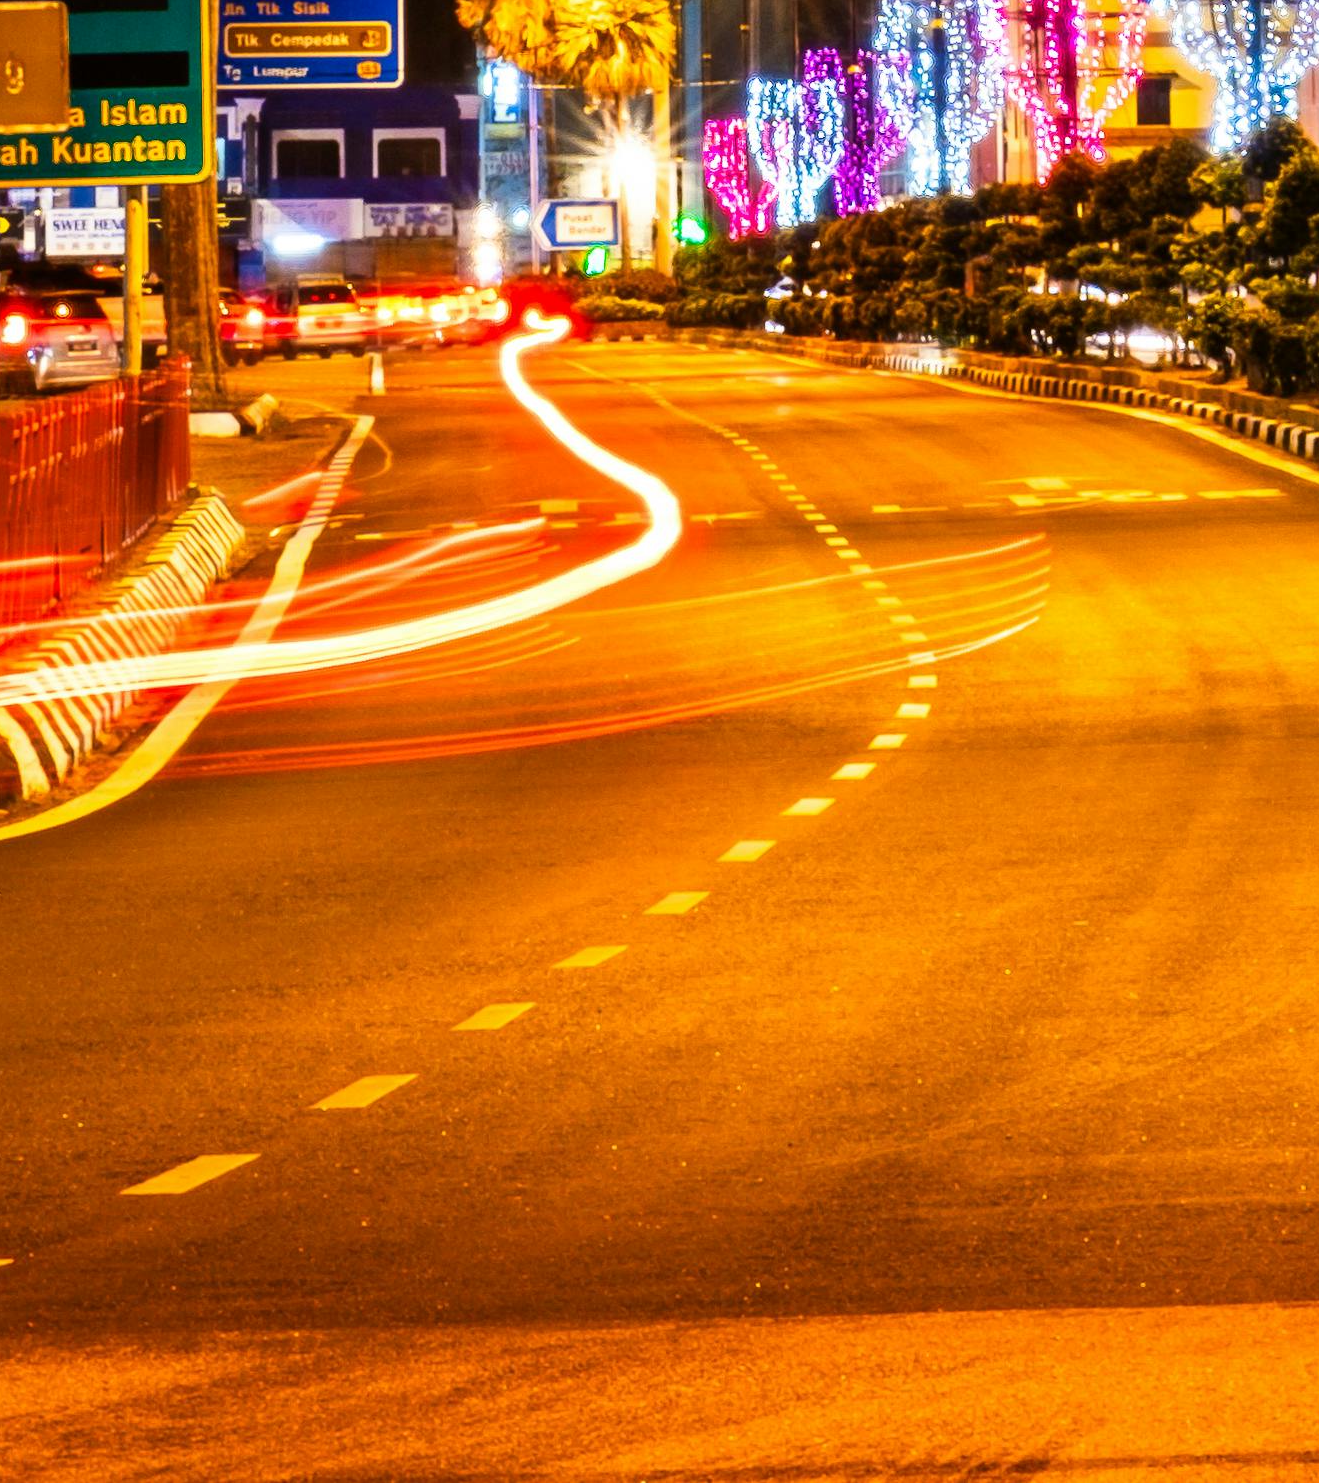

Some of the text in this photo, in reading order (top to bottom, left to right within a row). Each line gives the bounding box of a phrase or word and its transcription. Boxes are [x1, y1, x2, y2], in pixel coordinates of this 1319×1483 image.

[223, 1, 330, 16] Jln Tlk Sisik
[235, 33, 350, 49] Tlk Cempedak
[100, 99, 188, 127] Islam
[51, 135, 187, 164] Kuantan
[53, 219, 88, 231] SWEE
